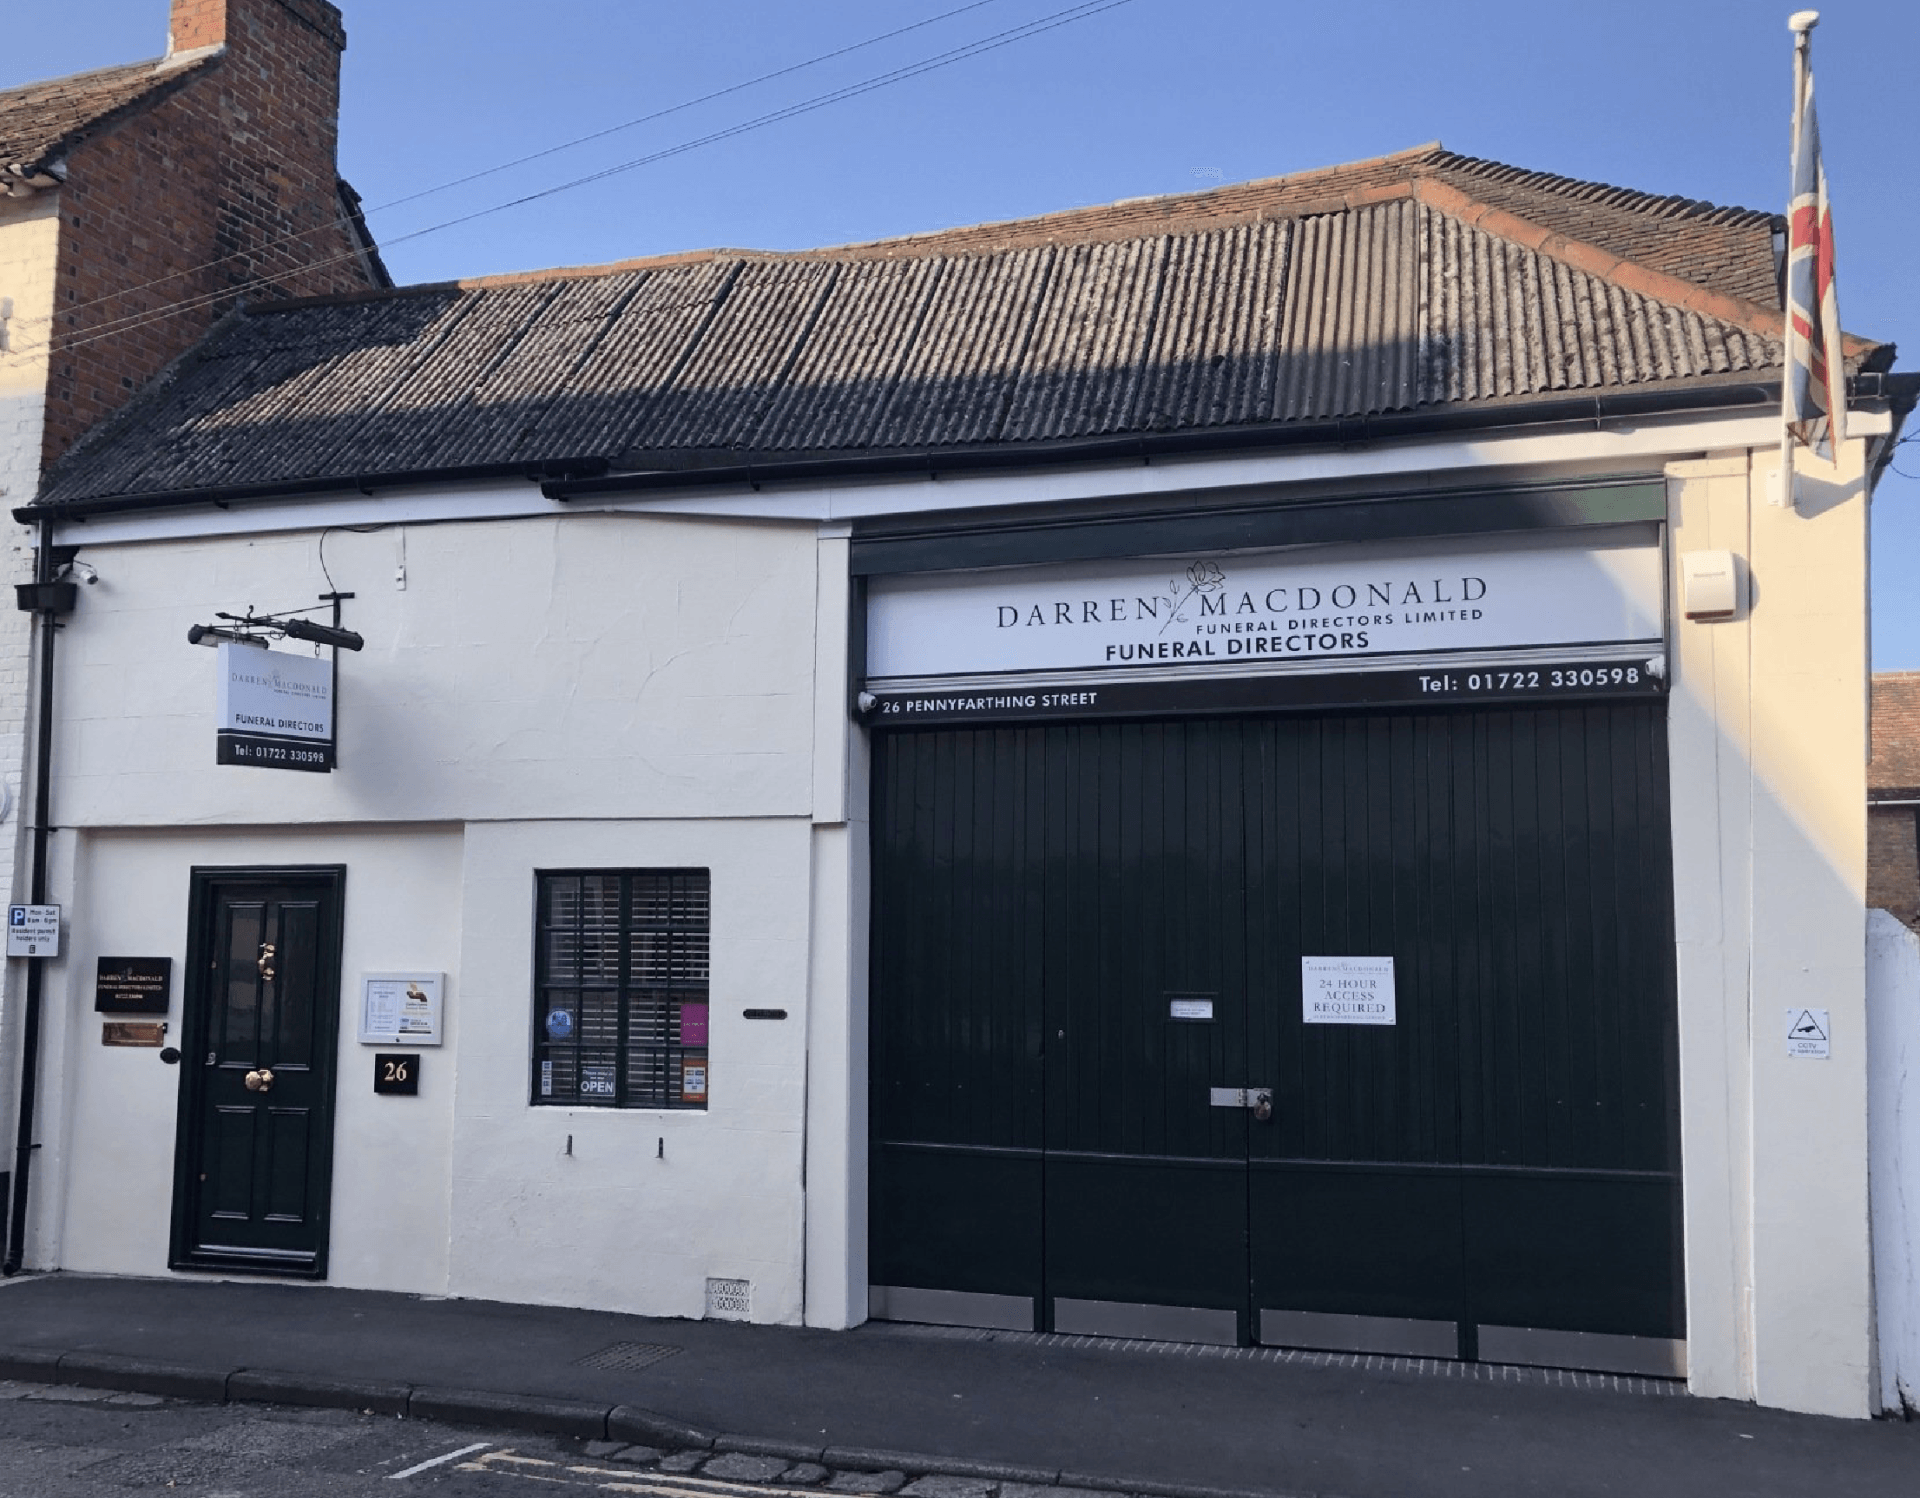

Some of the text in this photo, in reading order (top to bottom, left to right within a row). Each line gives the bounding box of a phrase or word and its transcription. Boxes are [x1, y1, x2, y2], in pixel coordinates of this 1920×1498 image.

[996, 577, 1487, 628] DARREN MACDONALD
[1196, 609, 1483, 635] FUNERAL DIRECTORS LIMITED
[1106, 631, 1369, 661] FUNERAL DIRECTORS
[1419, 667, 1639, 692] Tel: 01722 330598
[882, 692, 1098, 713] 26 PENNYFARTHING STREET
[235, 713, 324, 733] FUNERAL DIRECTORS
[235, 744, 324, 763] Tel: 01722 330598
[14, 910, 25, 924] P
[1319, 979, 1377, 989] 24 HOUR
[1323, 991, 1375, 1001] ACCESS
[1314, 1002, 1386, 1014] REQUIRED
[384, 1061, 408, 1081] 26
[580, 1081, 614, 1093] OPEN
